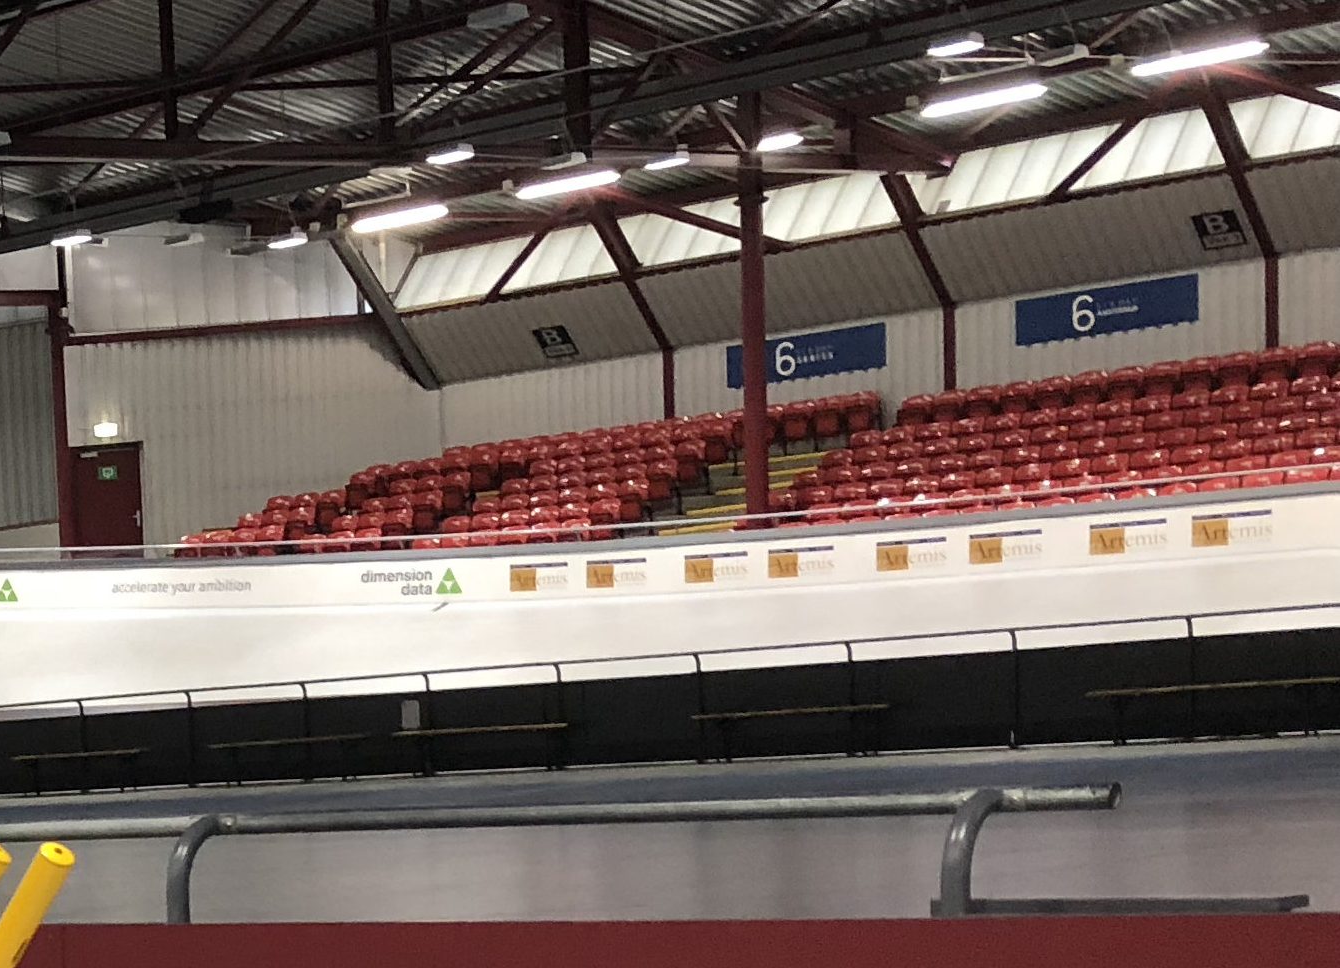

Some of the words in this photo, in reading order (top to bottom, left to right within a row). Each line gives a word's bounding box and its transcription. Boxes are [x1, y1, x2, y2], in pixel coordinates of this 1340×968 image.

[1202, 215, 1229, 234] B
[1072, 295, 1096, 332] 6
[541, 330, 562, 345] B
[775, 341, 796, 376] 6
[361, 568, 433, 583] dimension
[112, 581, 170, 594] accelerate
[171, 583, 195, 596] your
[198, 579, 252, 593] ambition
[401, 583, 433, 596] data
